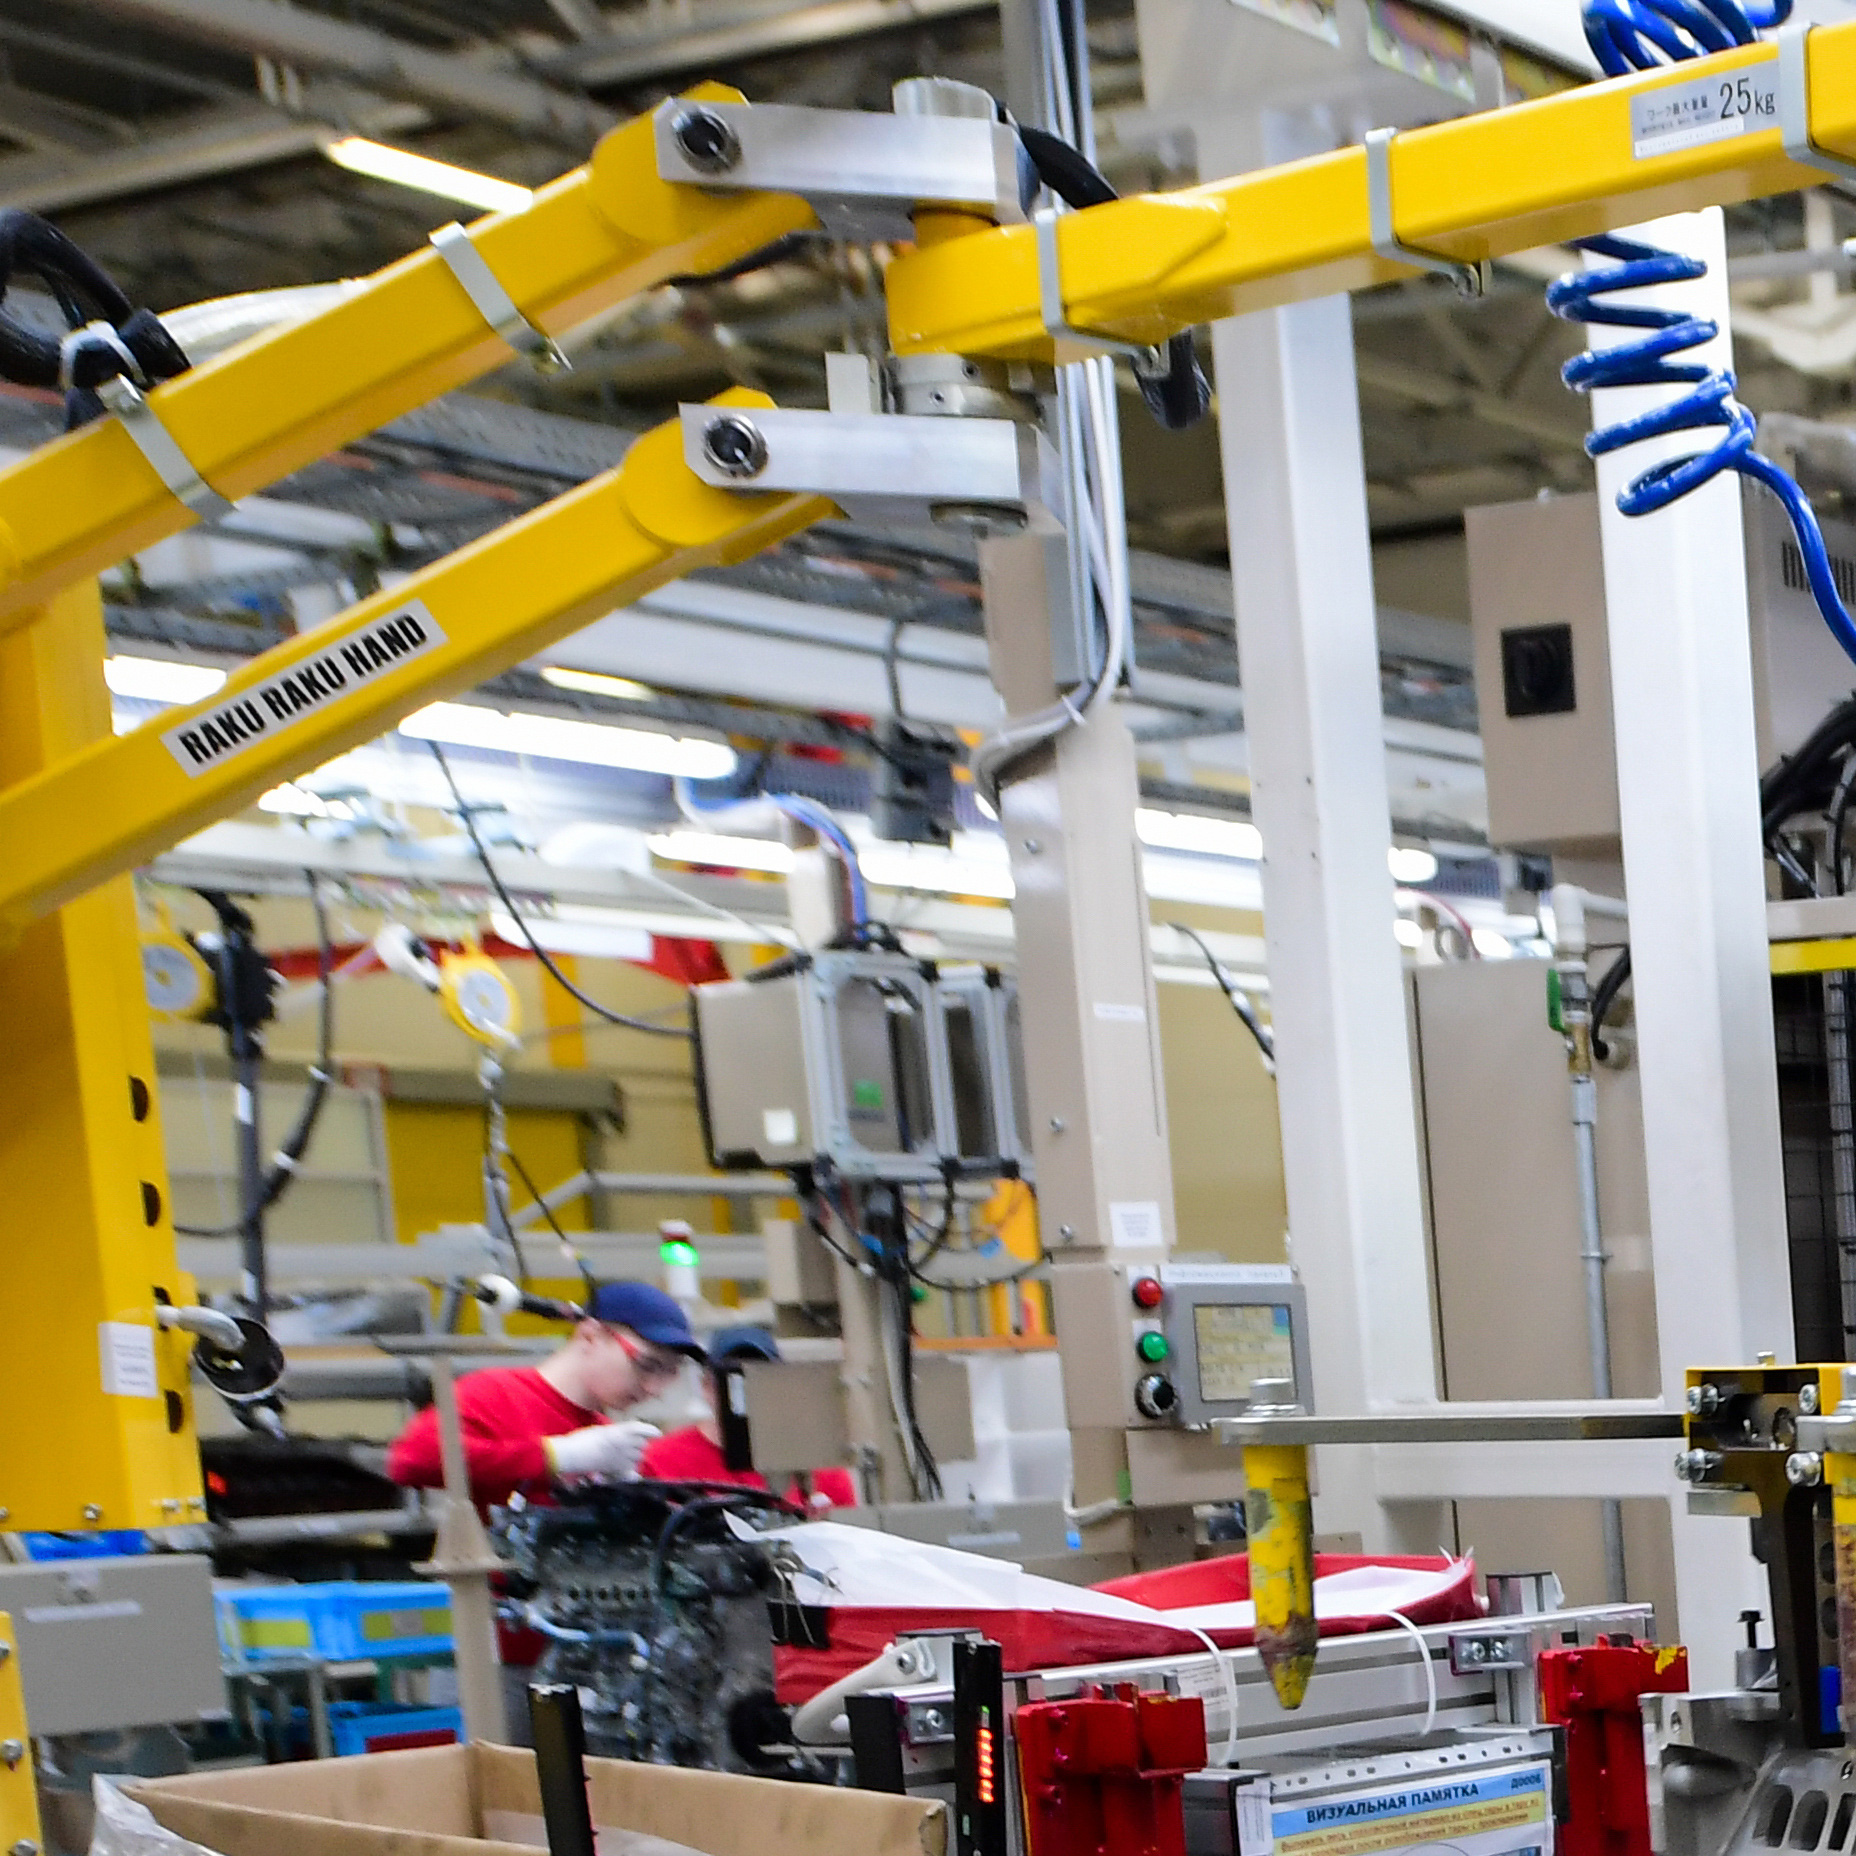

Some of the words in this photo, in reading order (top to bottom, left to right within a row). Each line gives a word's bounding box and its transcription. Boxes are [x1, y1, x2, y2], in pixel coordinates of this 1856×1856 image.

[178, 699, 266, 765] RAKU
[259, 655, 347, 721] RAKU
[340, 613, 428, 678] HAND
[1306, 1796, 1407, 1824] ВИЗУАЛЬНАЯ
[1411, 1783, 1479, 1807] ПАМЯТКА
